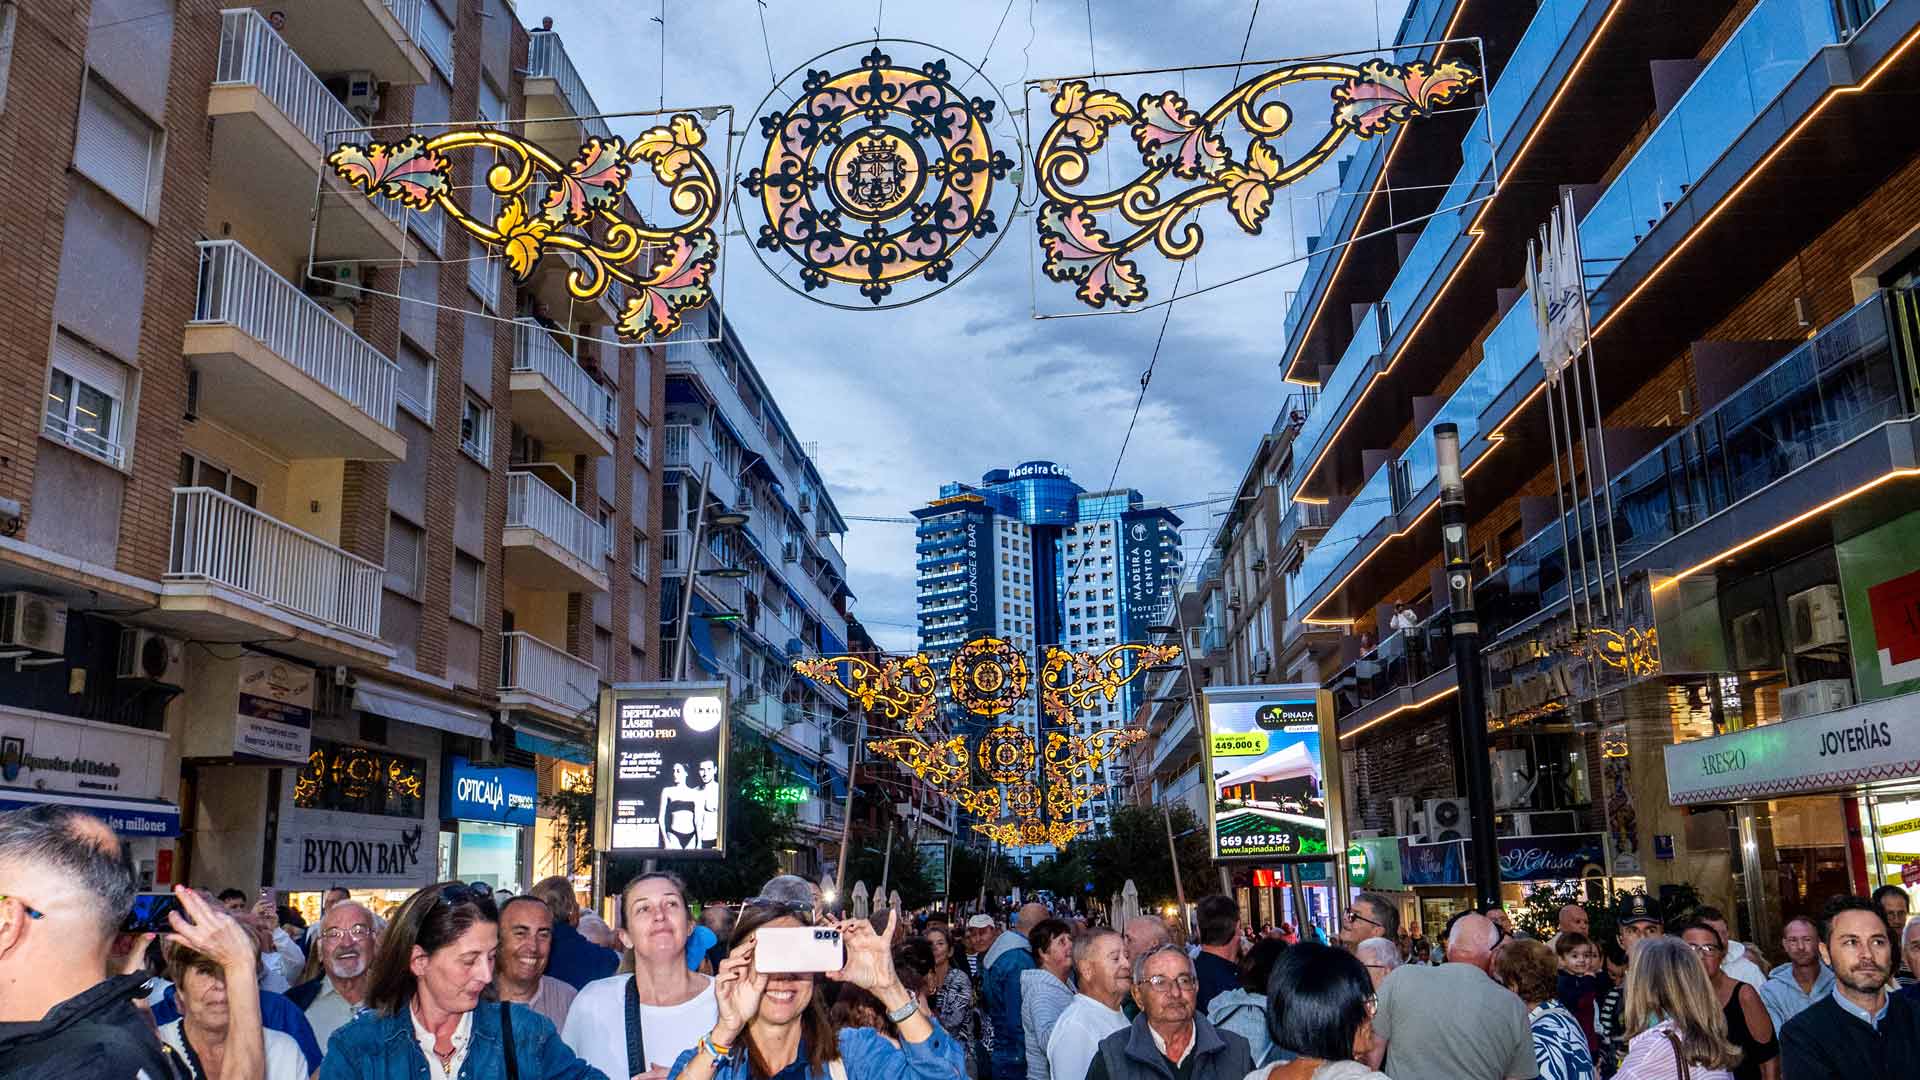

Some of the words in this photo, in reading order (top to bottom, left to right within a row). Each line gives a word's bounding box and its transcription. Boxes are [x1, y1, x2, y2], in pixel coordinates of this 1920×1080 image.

[1008, 464, 1048, 479] Madeira
[968, 523, 977, 548] BAR
[968, 550, 977, 558] &
[1131, 547, 1142, 600] MADEIRA
[1144, 549, 1154, 594] CENTRO
[968, 559, 978, 612] LOUNGE
[622, 707, 680, 718] DEPILACIÓN
[1263, 712, 1275, 720] LA
[1282, 711, 1314, 719] PINADA
[622, 716, 653, 728] LÁSER
[622, 729, 654, 739] DIODO
[655, 729, 677, 738] PRO
[1819, 719, 1891, 757] JOYERÍAS
[1215, 741, 1252, 750] 449.000
[1255, 740, 1261, 748] €
[71, 758, 88, 774] del
[125, 816, 166, 832] millones
[1220, 836, 1242, 847] 669
[1244, 835, 1265, 845] 412
[1268, 834, 1290, 845] 252
[302, 838, 374, 874] BYRON
[375, 843, 408, 874] BAY
[1221, 844, 1291, 854] www.lapinada.info
[1500, 848, 1576, 872] Melissa
